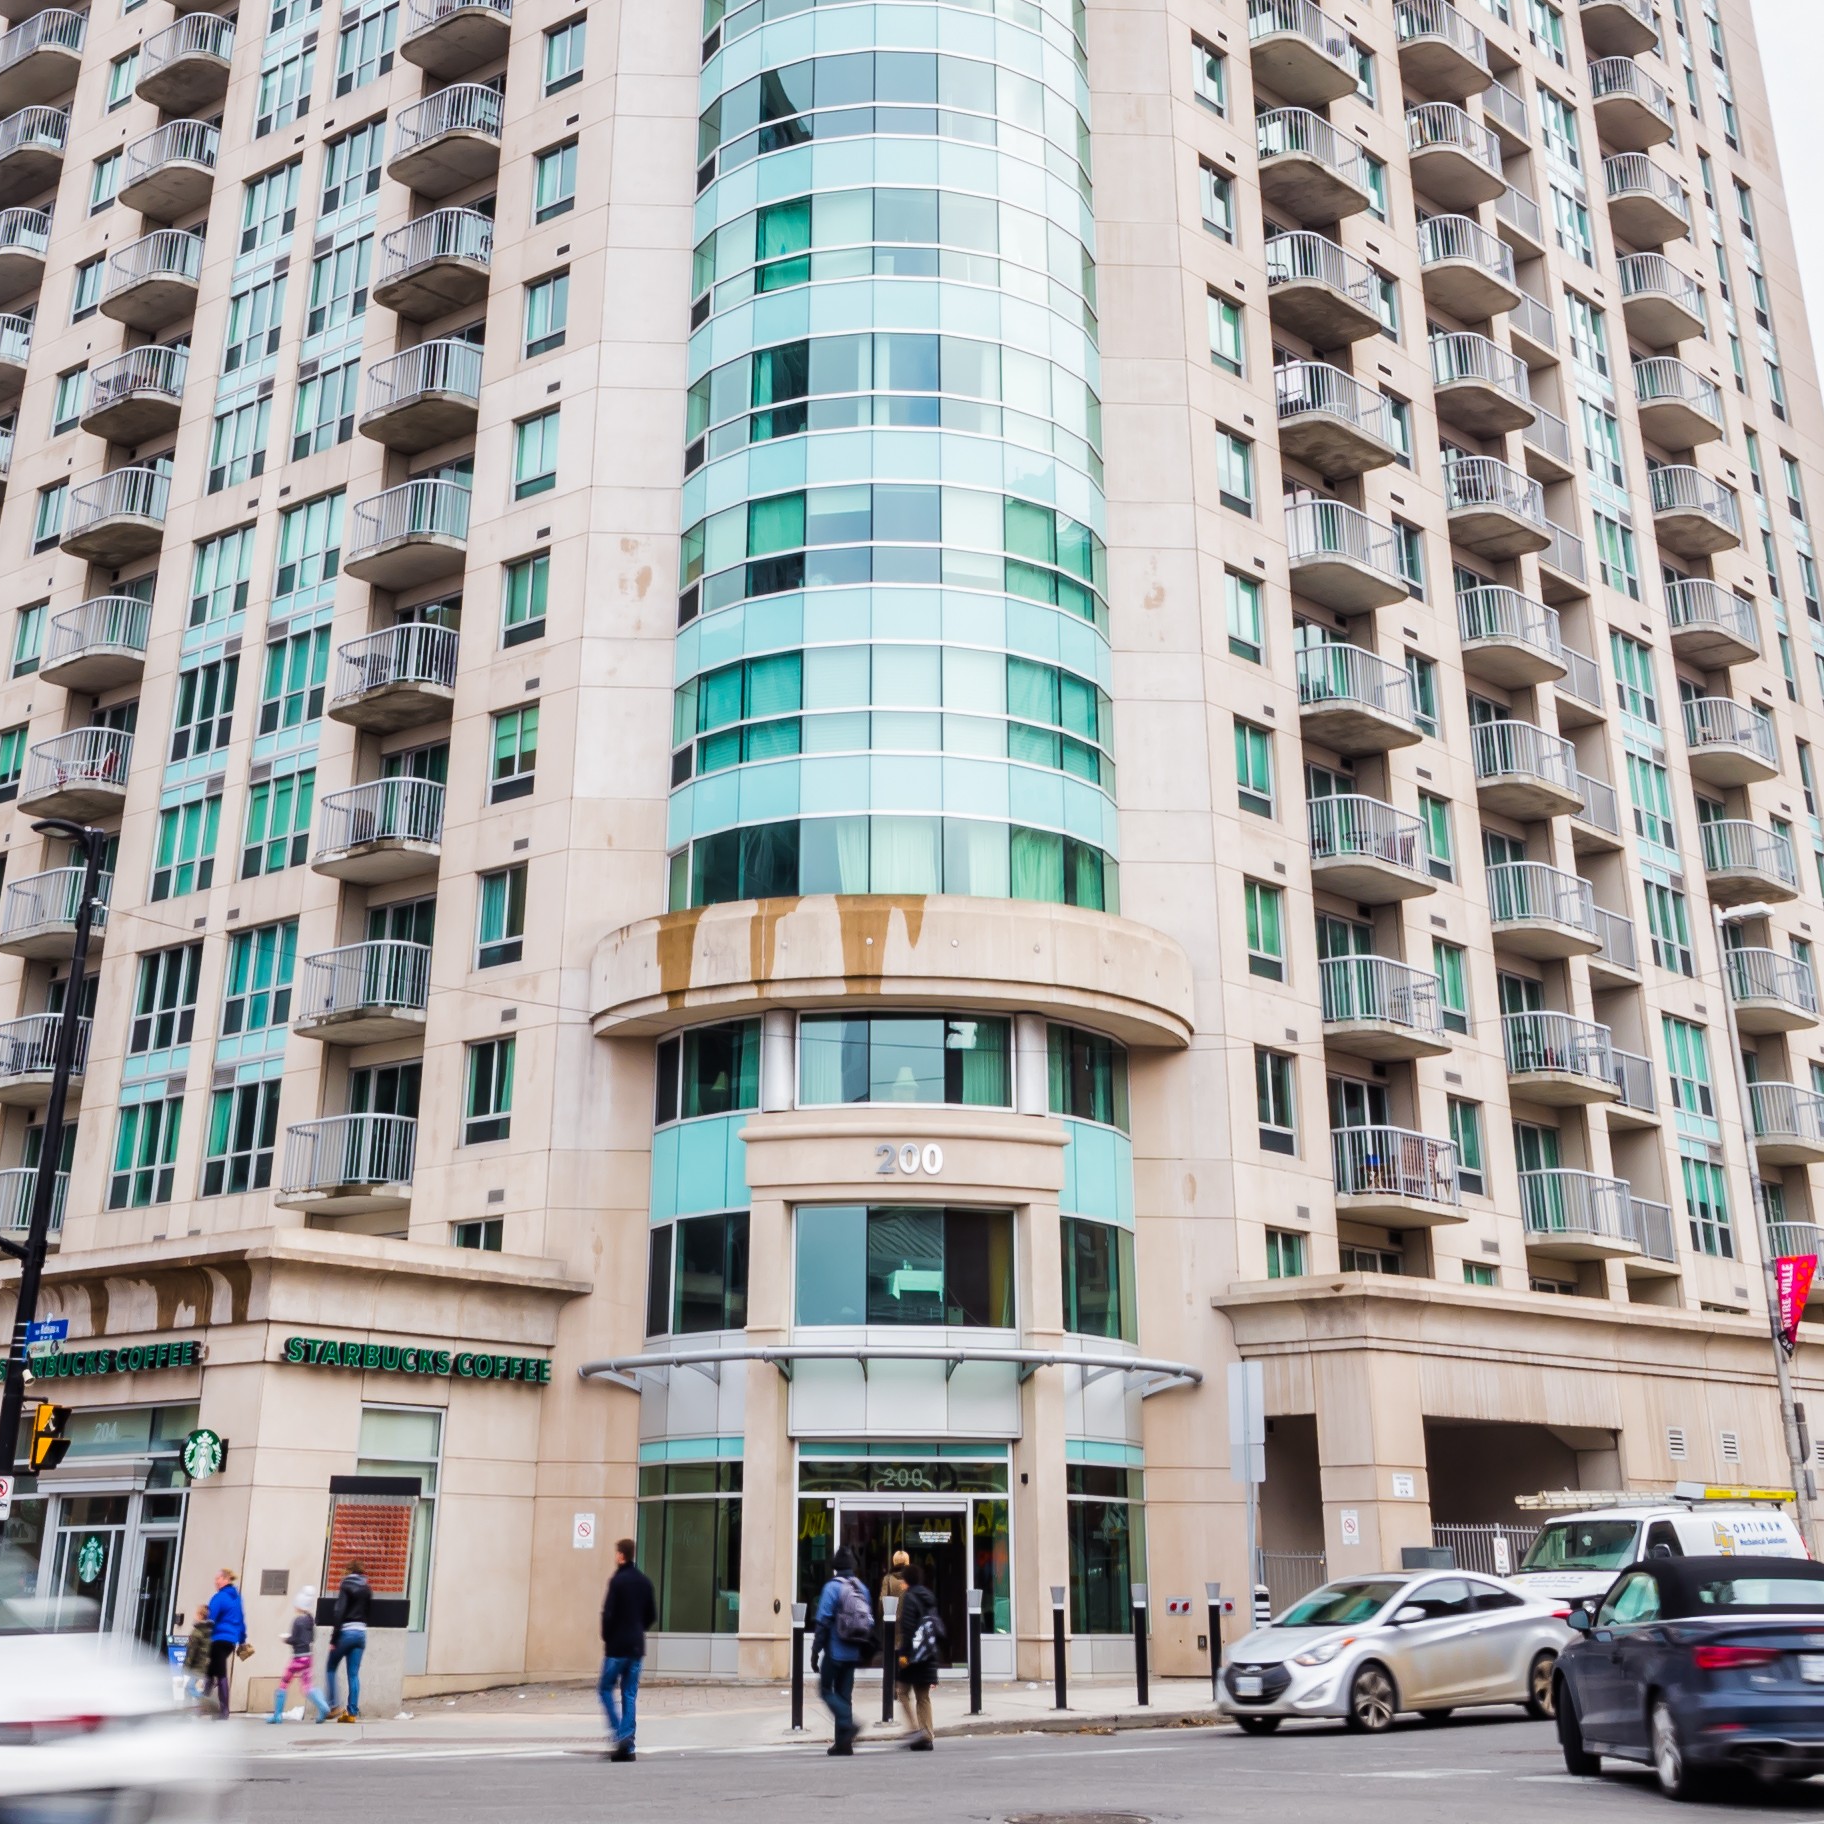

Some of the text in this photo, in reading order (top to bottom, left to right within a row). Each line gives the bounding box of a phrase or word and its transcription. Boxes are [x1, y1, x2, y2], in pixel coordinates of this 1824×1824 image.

[875, 1142, 944, 1175] 200
[1781, 1263, 1793, 1328] NTRE-VILLE
[116, 1341, 195, 1372] COFFEE
[287, 1336, 553, 1383] STARBUCKS COFFEE
[94, 1421, 118, 1442] 204
[883, 1468, 923, 1487] 200
[1733, 1522, 1783, 1533] OPTIMUM
